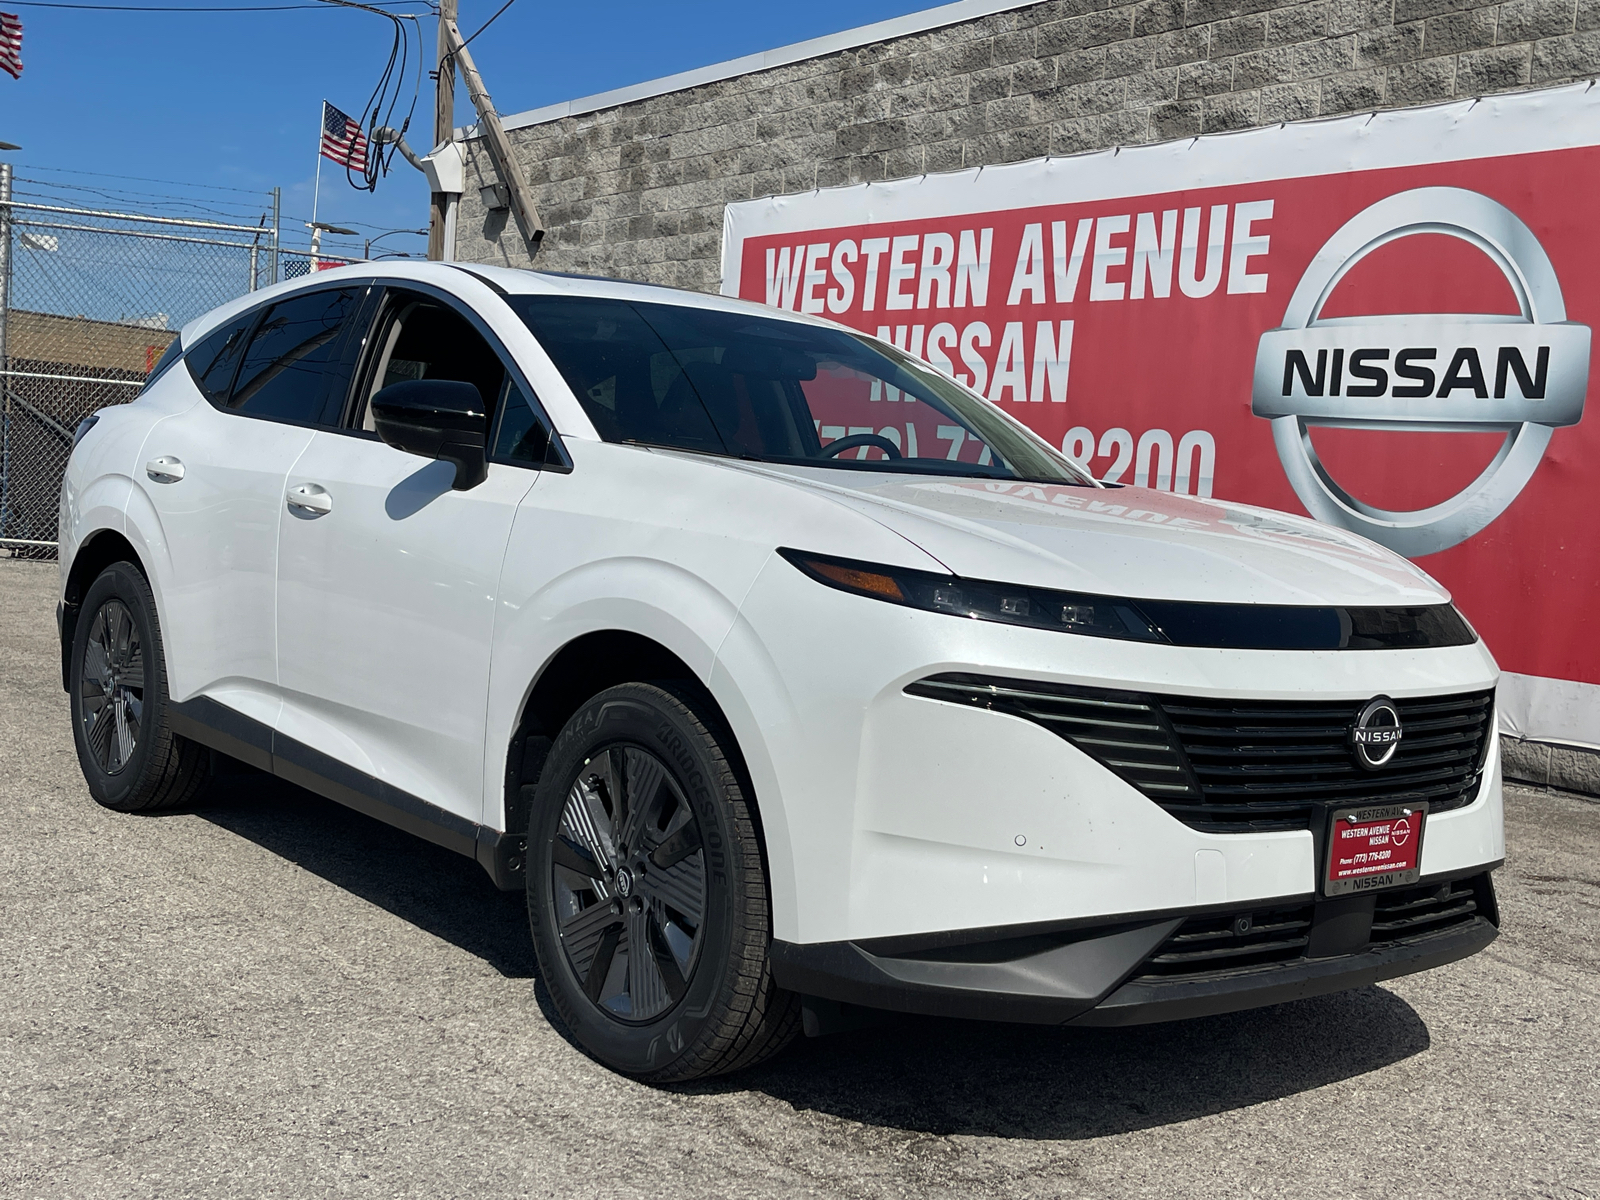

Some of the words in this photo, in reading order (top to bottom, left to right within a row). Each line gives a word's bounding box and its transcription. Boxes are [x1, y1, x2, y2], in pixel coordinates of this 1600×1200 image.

[765, 227, 994, 314] WESTERN
[1006, 199, 1275, 306] AVENUE
[869, 319, 1075, 403] NISSAN
[1281, 346, 1551, 400] NISSAN
[1355, 728, 1403, 742] NISSAN
[655, 720, 728, 886] BRIDGESTONE
[1356, 807, 1391, 820] WESTERN
[1341, 827, 1369, 839] WESTERN
[1369, 824, 1391, 835] AVENUE
[1391, 828, 1411, 836] NISSAN
[1369, 834, 1390, 846] NISSAN
[1353, 852, 1368, 865] (773)
[1352, 874, 1394, 890] NISSAN
